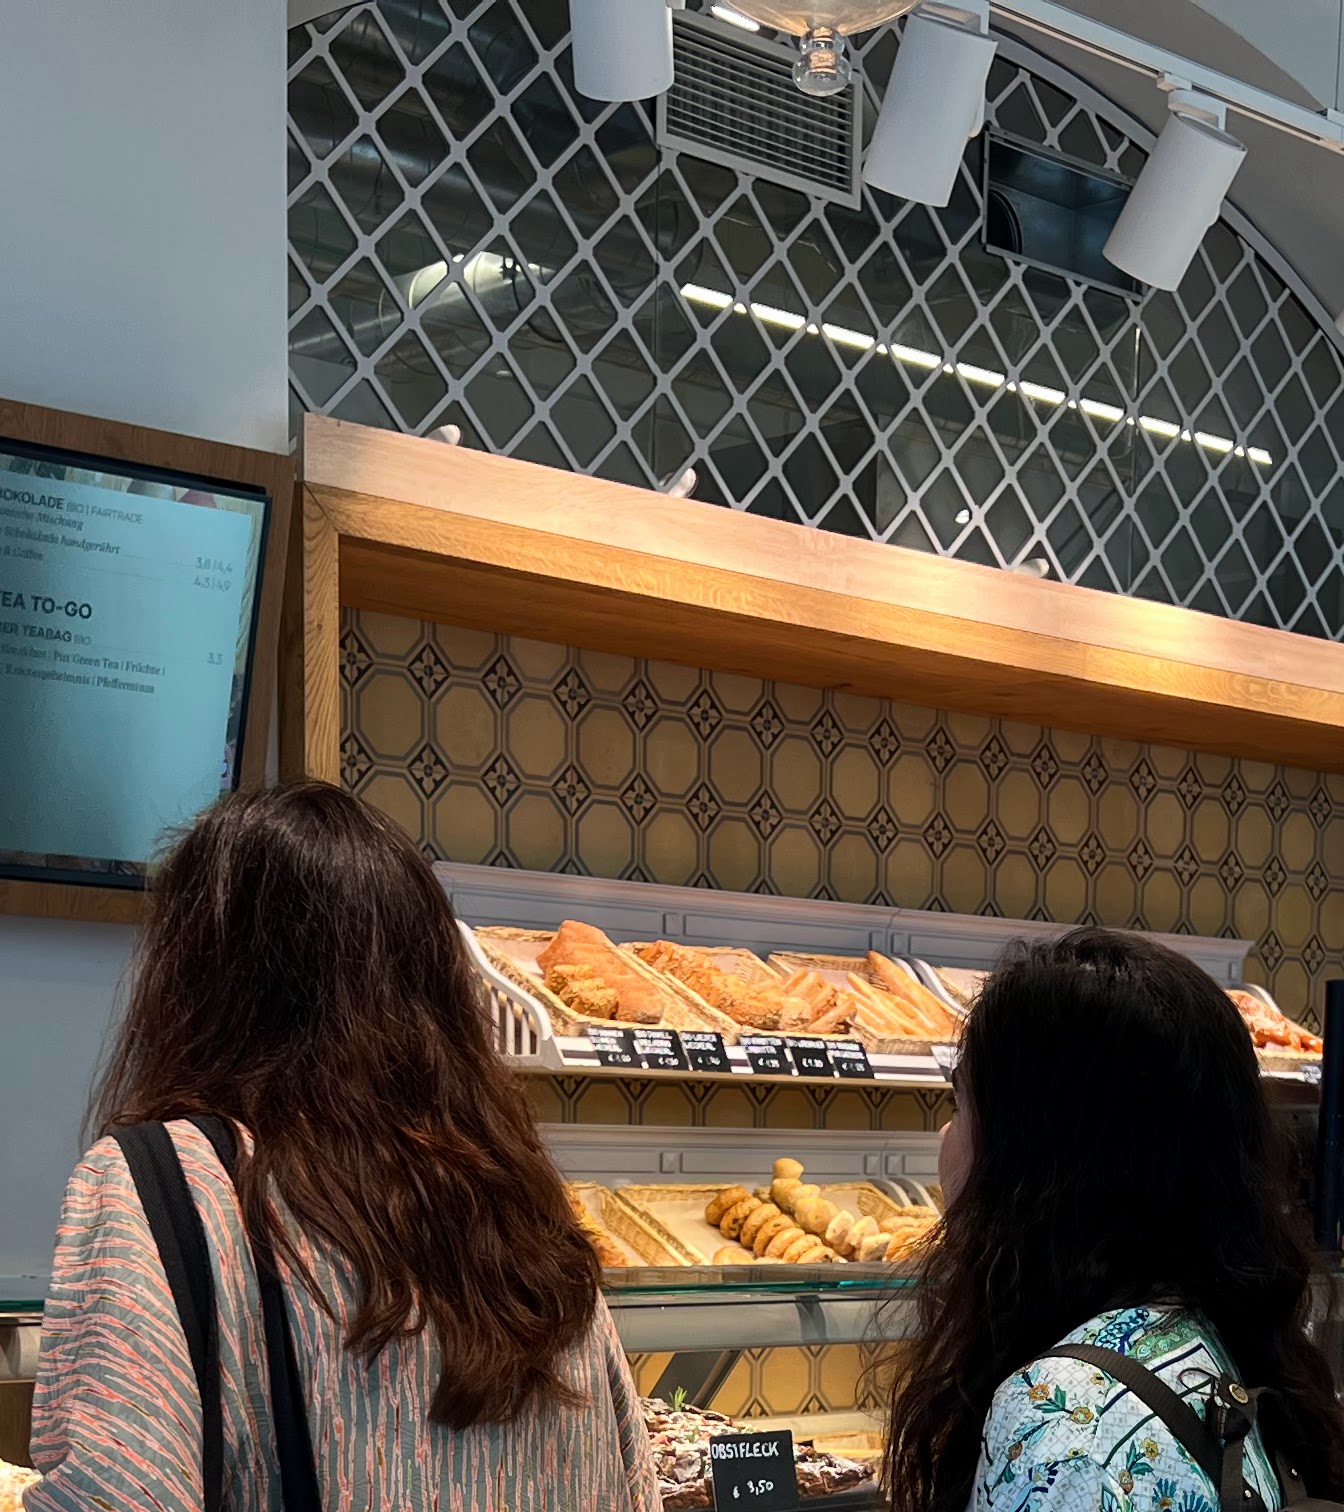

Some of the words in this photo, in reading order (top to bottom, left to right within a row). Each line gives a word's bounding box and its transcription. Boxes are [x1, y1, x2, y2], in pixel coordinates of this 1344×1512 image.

[91, 506, 144, 524] FAIRTRADE
[31, 595, 92, 620] TO-GO
[710, 1442, 779, 1461] OBSTFLECK
[748, 1478, 774, 1494] 3,50
